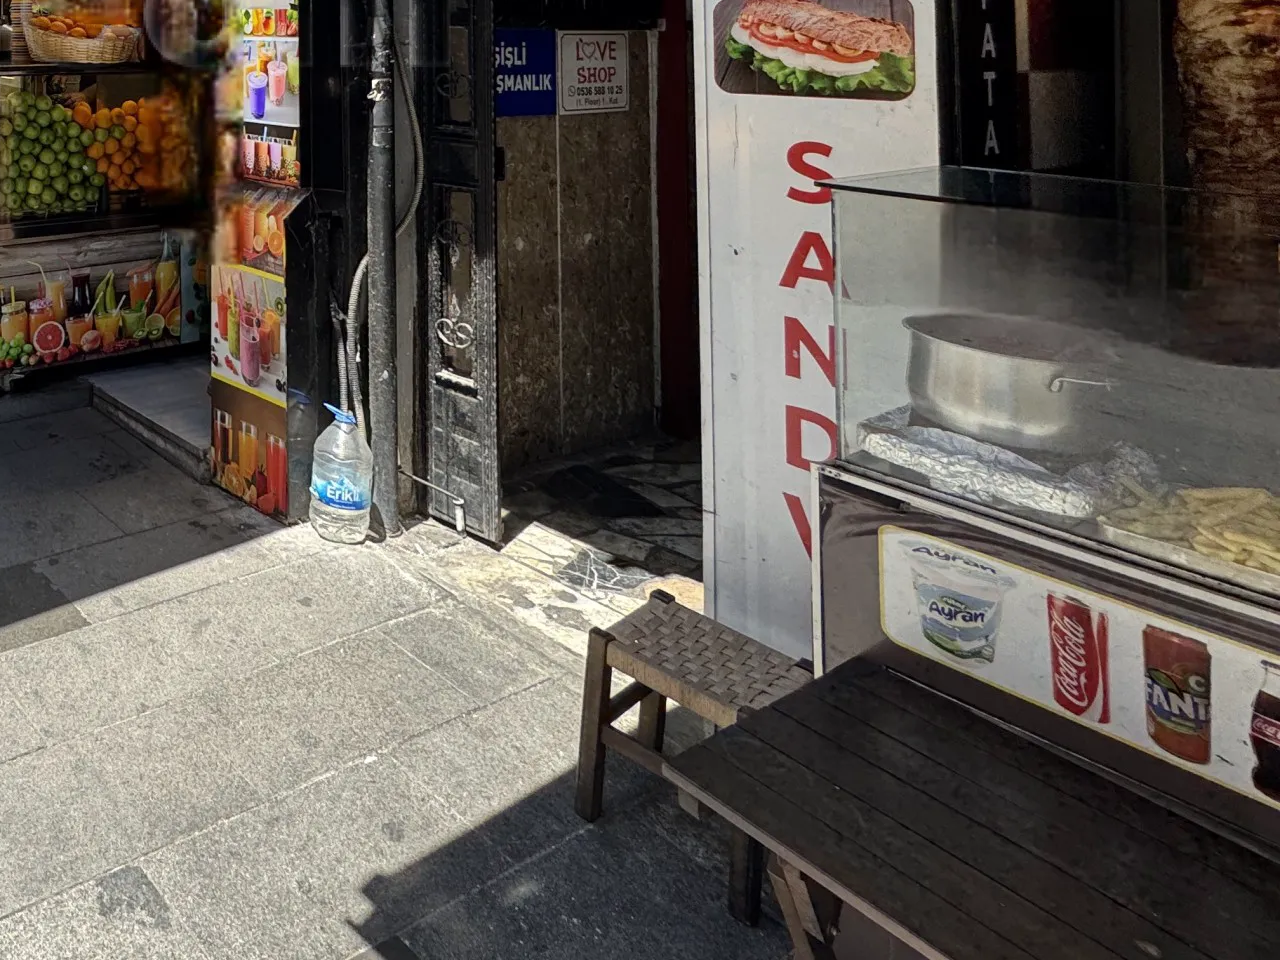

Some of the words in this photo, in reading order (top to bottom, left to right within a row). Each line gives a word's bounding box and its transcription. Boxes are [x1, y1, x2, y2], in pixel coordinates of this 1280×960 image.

[575, 39, 617, 62] LOVE
[577, 66, 617, 84] SHOP
[326, 485, 360, 502] Erikli
[928, 600, 986, 624] Ayran
